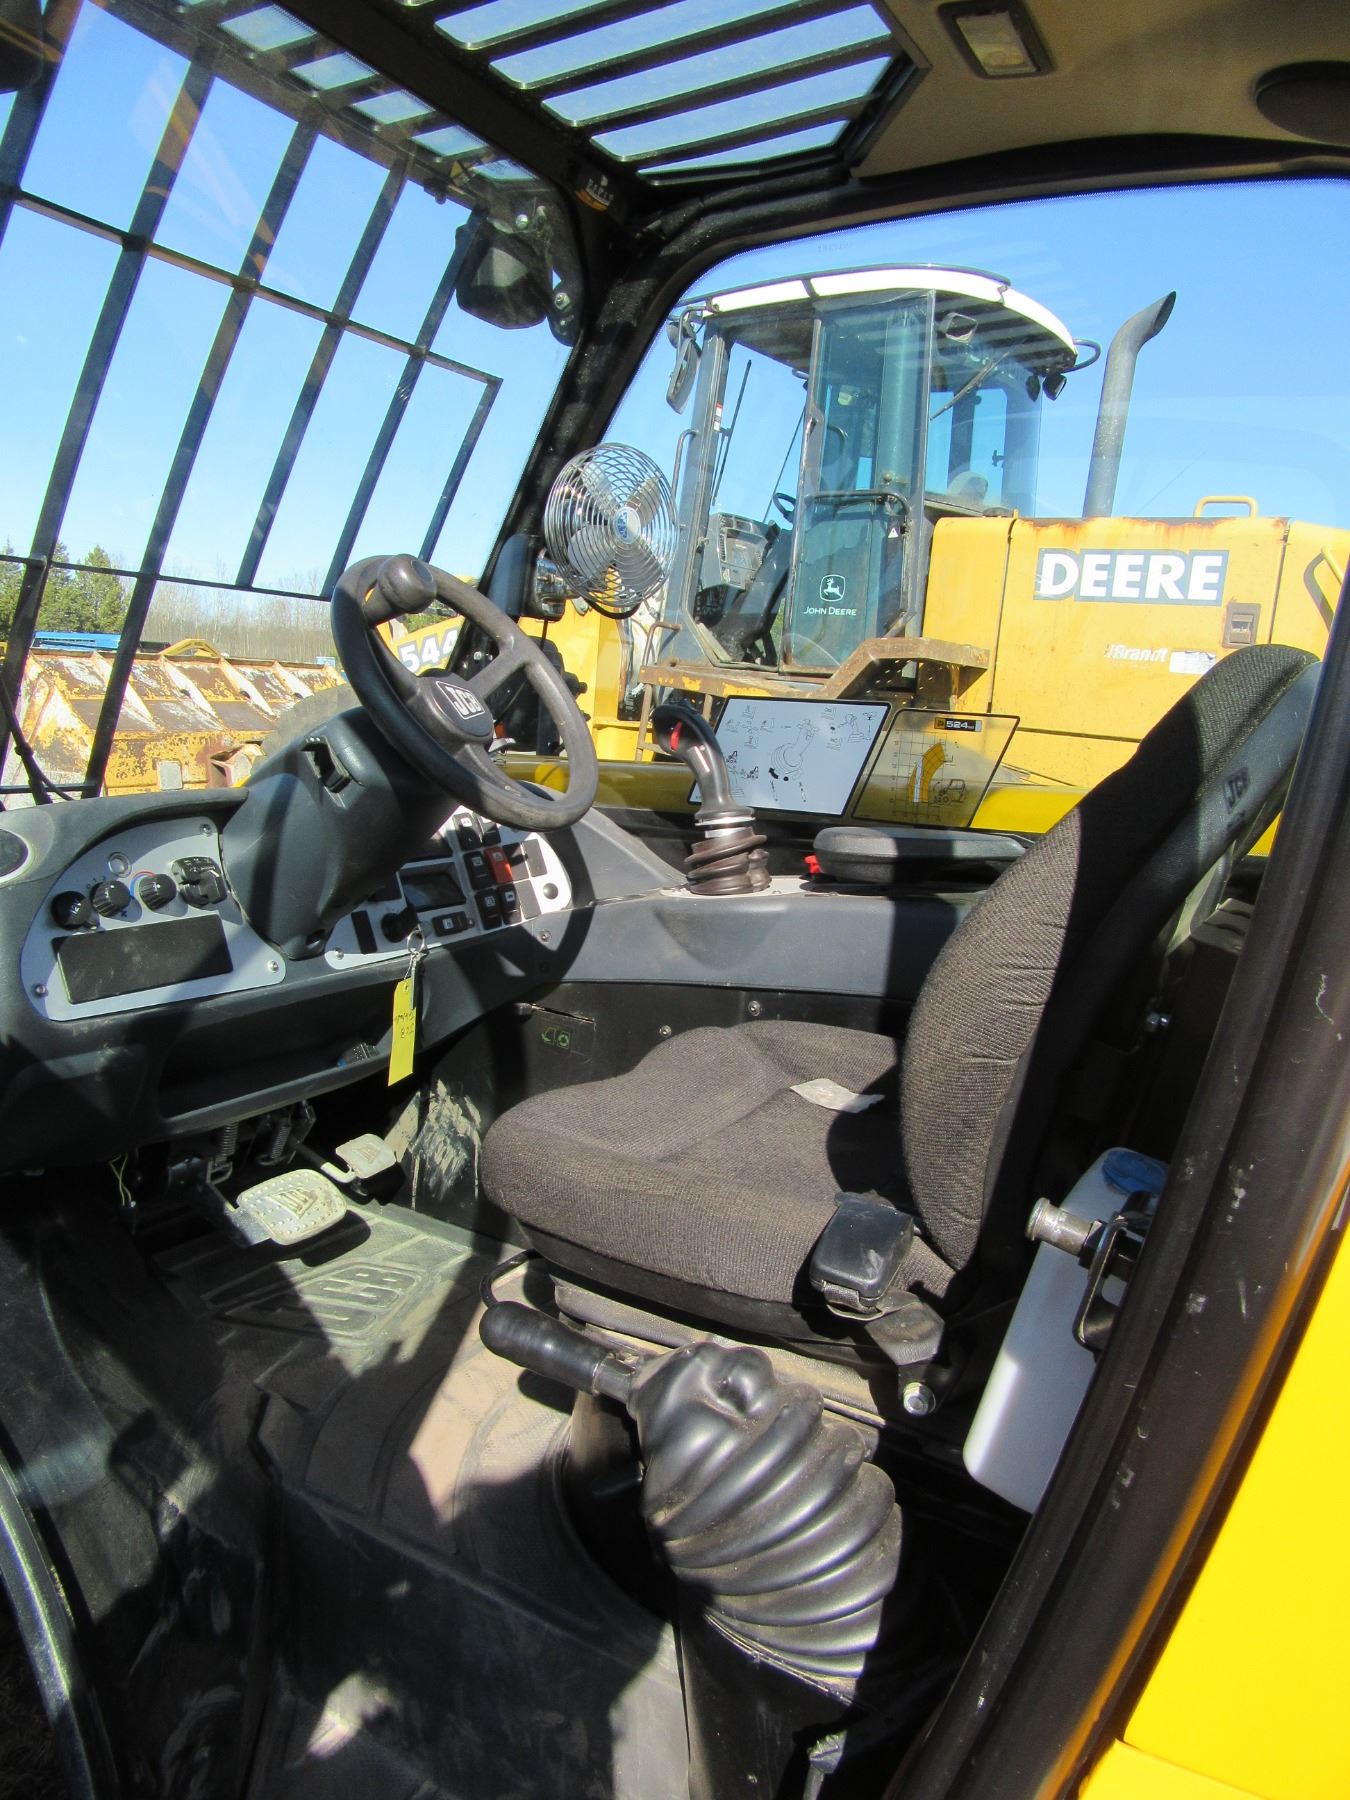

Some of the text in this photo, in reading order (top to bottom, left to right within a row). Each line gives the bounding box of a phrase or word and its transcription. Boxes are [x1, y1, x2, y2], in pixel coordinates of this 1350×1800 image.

[1039, 553, 1223, 601] DEERE
[803, 606, 857, 616] JOHN DEERE
[444, 685, 483, 716] JCB
